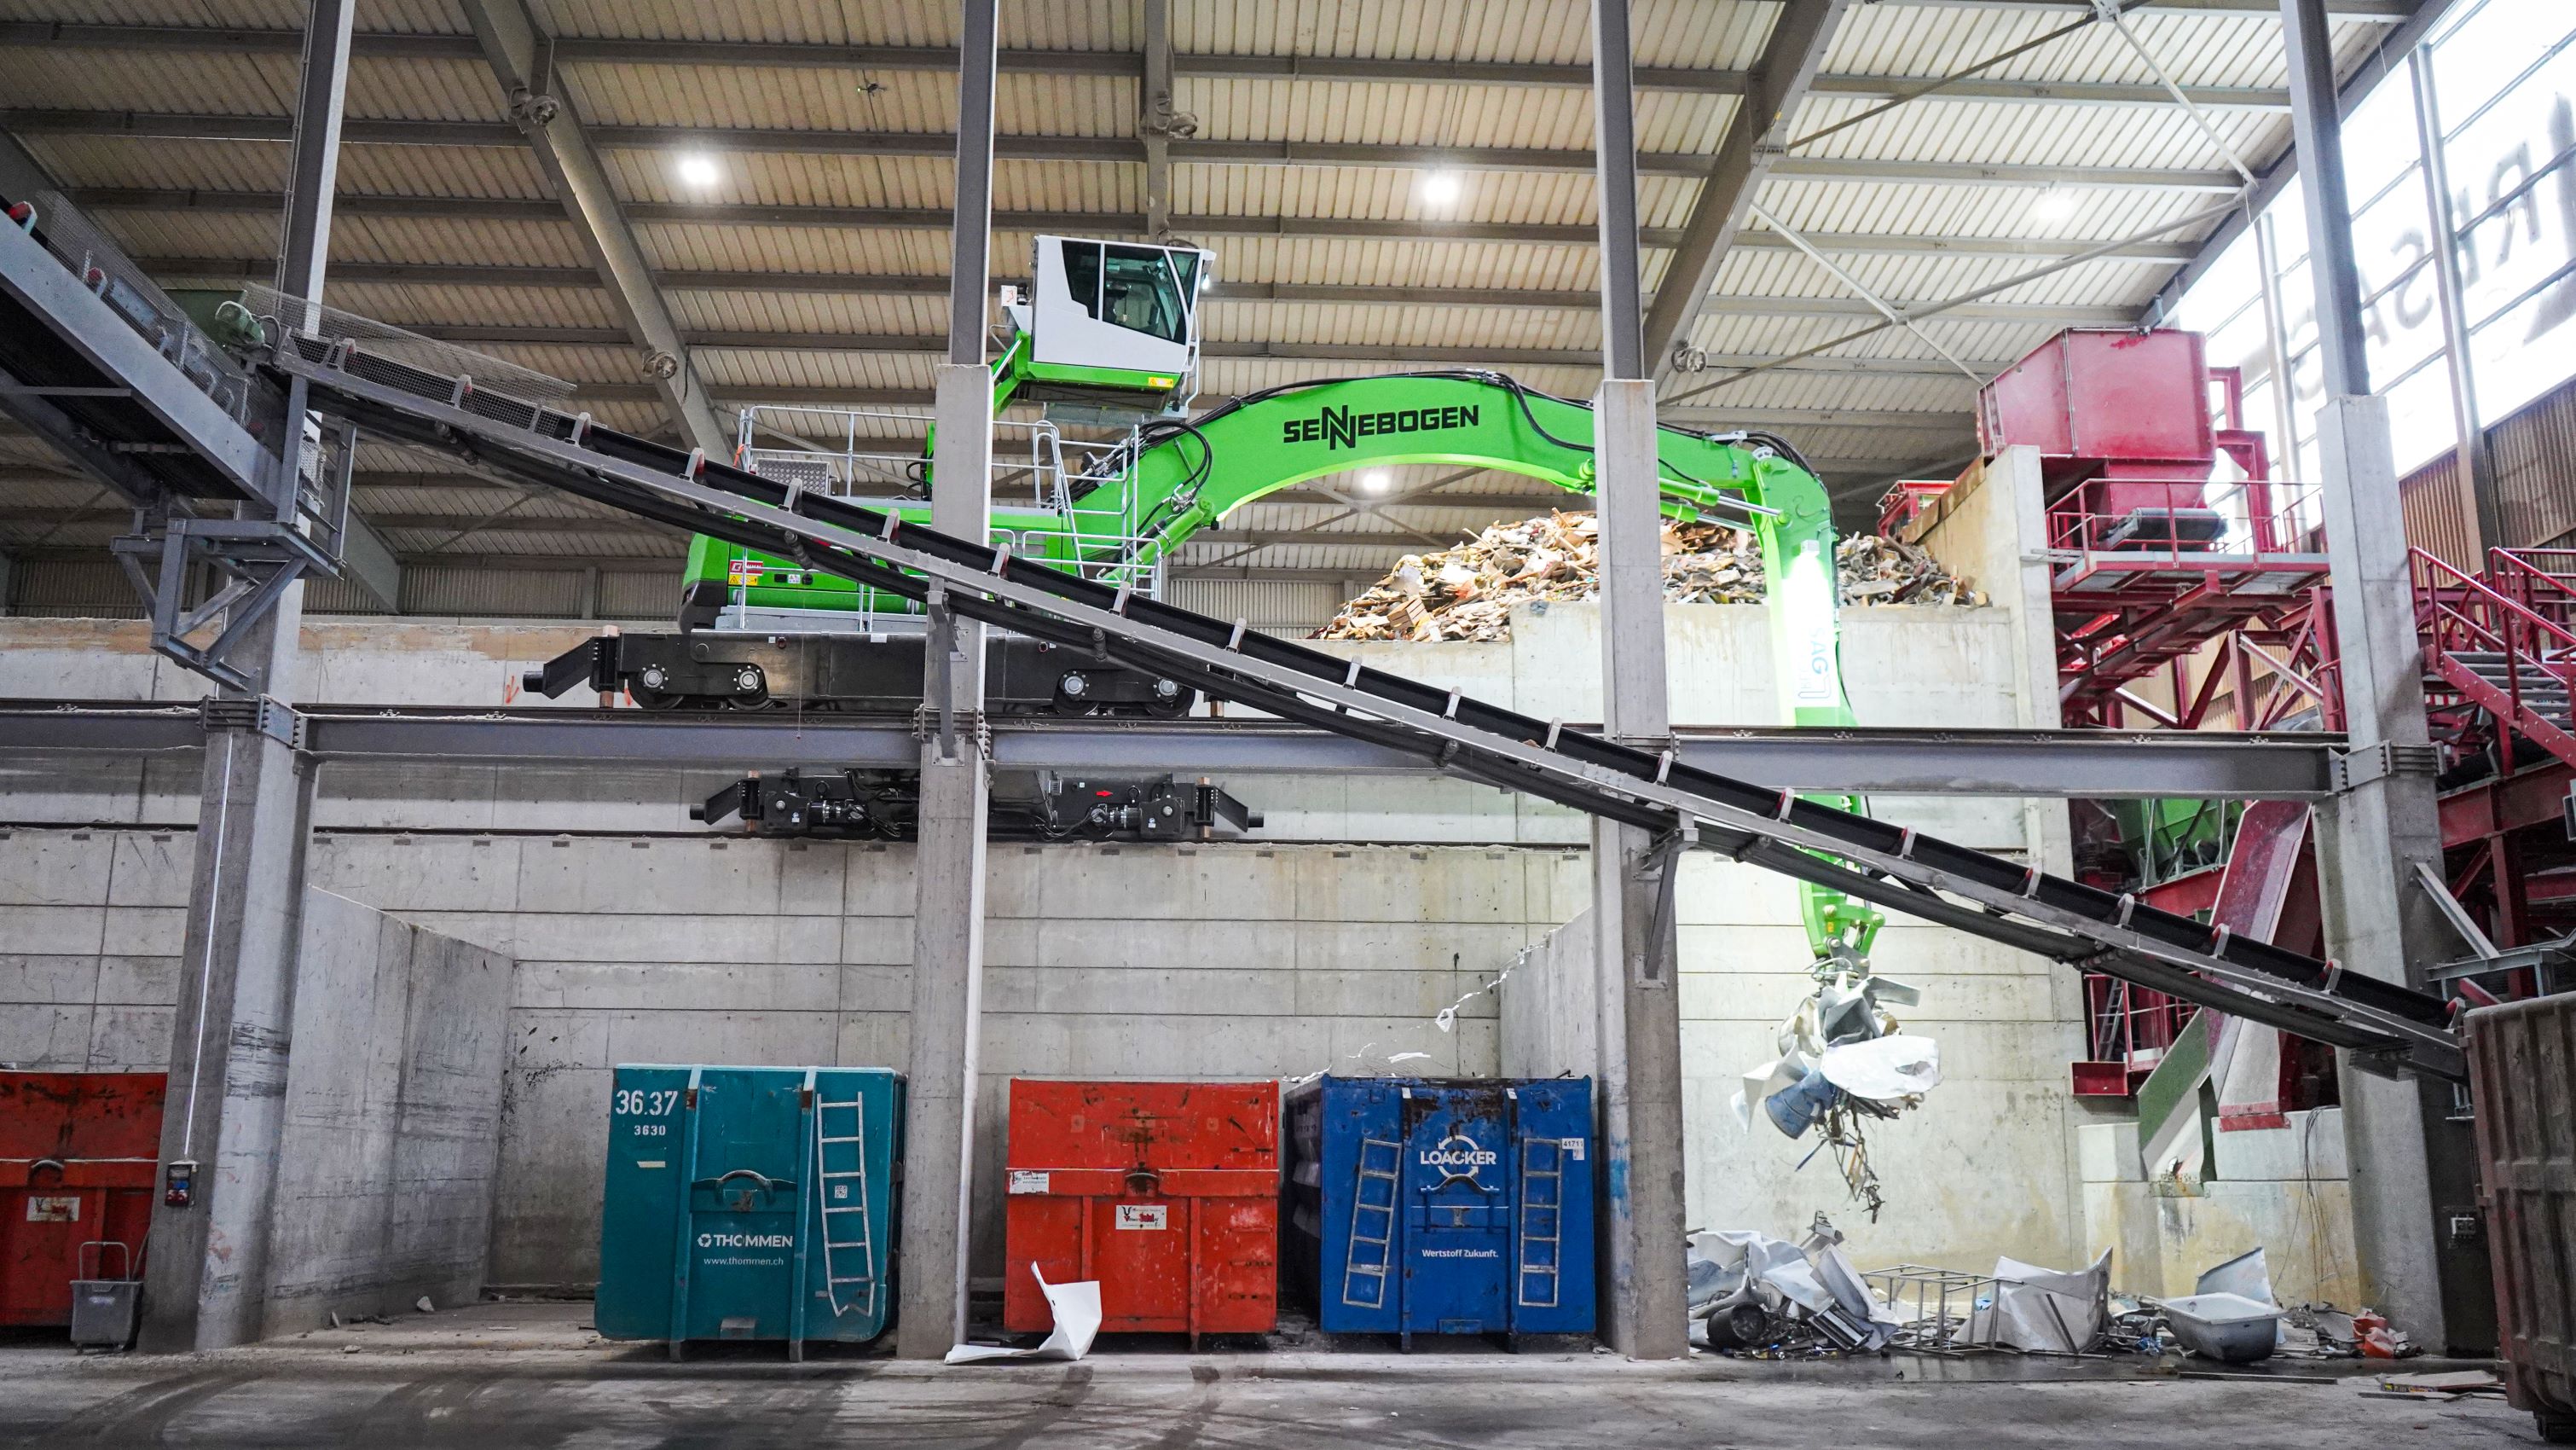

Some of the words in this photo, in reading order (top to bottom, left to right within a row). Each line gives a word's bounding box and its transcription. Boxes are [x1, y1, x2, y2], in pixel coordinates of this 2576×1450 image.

[1283, 404, 1479, 450] SENNEBOGEN
[615, 1089, 679, 1116] 36.37
[634, 1125, 666, 1136] 3630
[1420, 1151, 1496, 1165] LOACKER
[714, 1234, 793, 1247] THOMMEN
[1421, 1249, 1462, 1257] Wertstoff
[1464, 1249, 1499, 1257] Zukunft.
[703, 1256, 784, 1266] www.thommen.ch
